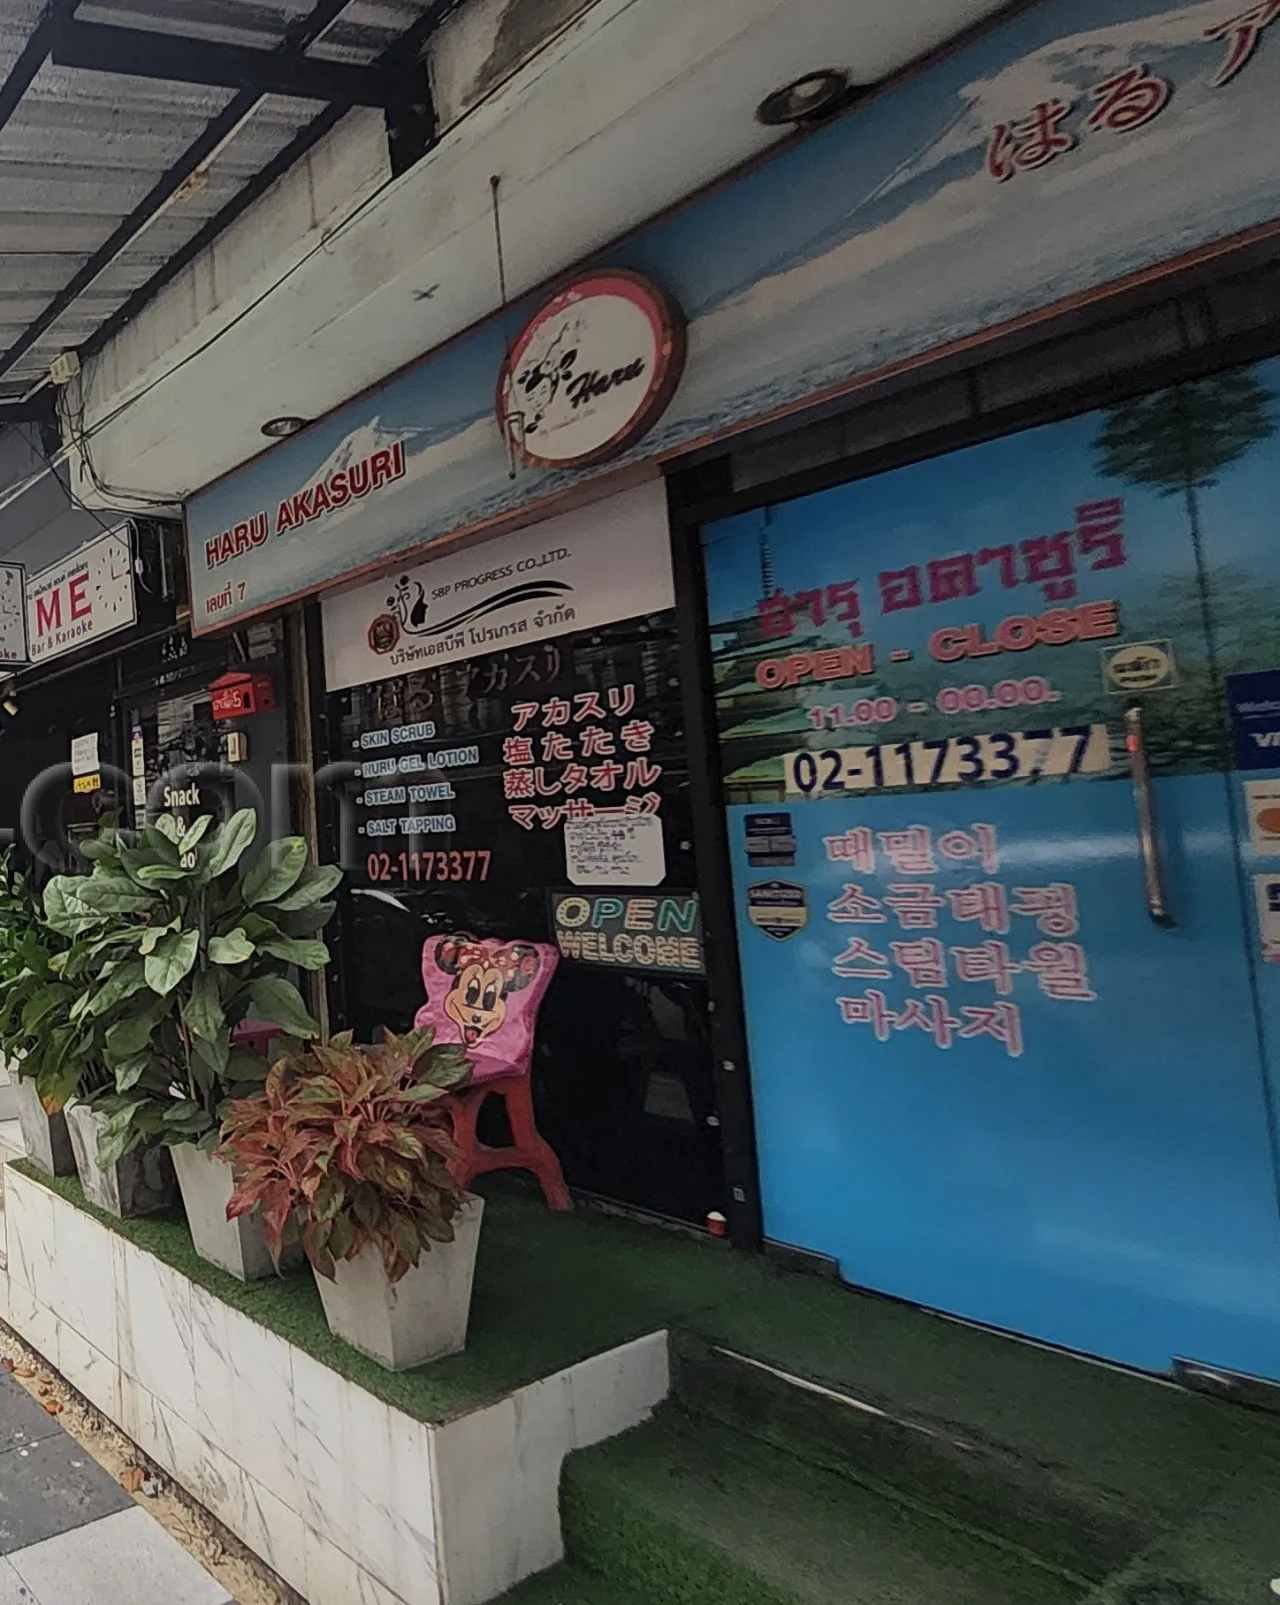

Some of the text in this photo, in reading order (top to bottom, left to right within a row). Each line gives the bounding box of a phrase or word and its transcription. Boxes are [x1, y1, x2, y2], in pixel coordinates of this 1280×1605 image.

[205, 441, 405, 570] HARU AKASURI
[236, 581, 247, 601] 7
[430, 584, 452, 601] SBP
[454, 565, 514, 594] PROGRESS
[532, 603, 577, 629] จำกัด
[31, 641, 45, 657] Bar
[55, 620, 94, 645] Karaoke
[755, 642, 874, 690] OPEN
[928, 600, 1119, 662] CLOSE
[510, 684, 636, 732] アカスリ
[808, 695, 899, 729] 11.00
[361, 721, 437, 749] SKIN SCRUB
[502, 719, 655, 766] 塩たたき
[398, 754, 426, 773] GEL
[427, 746, 480, 769] LOTION
[163, 782, 201, 808] Snack
[364, 782, 456, 806] STEAM TOWEL
[502, 757, 663, 799] 蒸しタオル
[366, 814, 457, 837] SALT TAPPING
[367, 850, 492, 882] 02-1173377
[822, 823, 1002, 876] 때밀이
[555, 897, 697, 933] OPEN
[826, 881, 1080, 938] 소금태핑
[555, 929, 702, 970] WELCOME
[831, 937, 1098, 1002] 스팀타월
[835, 989, 1025, 1058] 마사지
